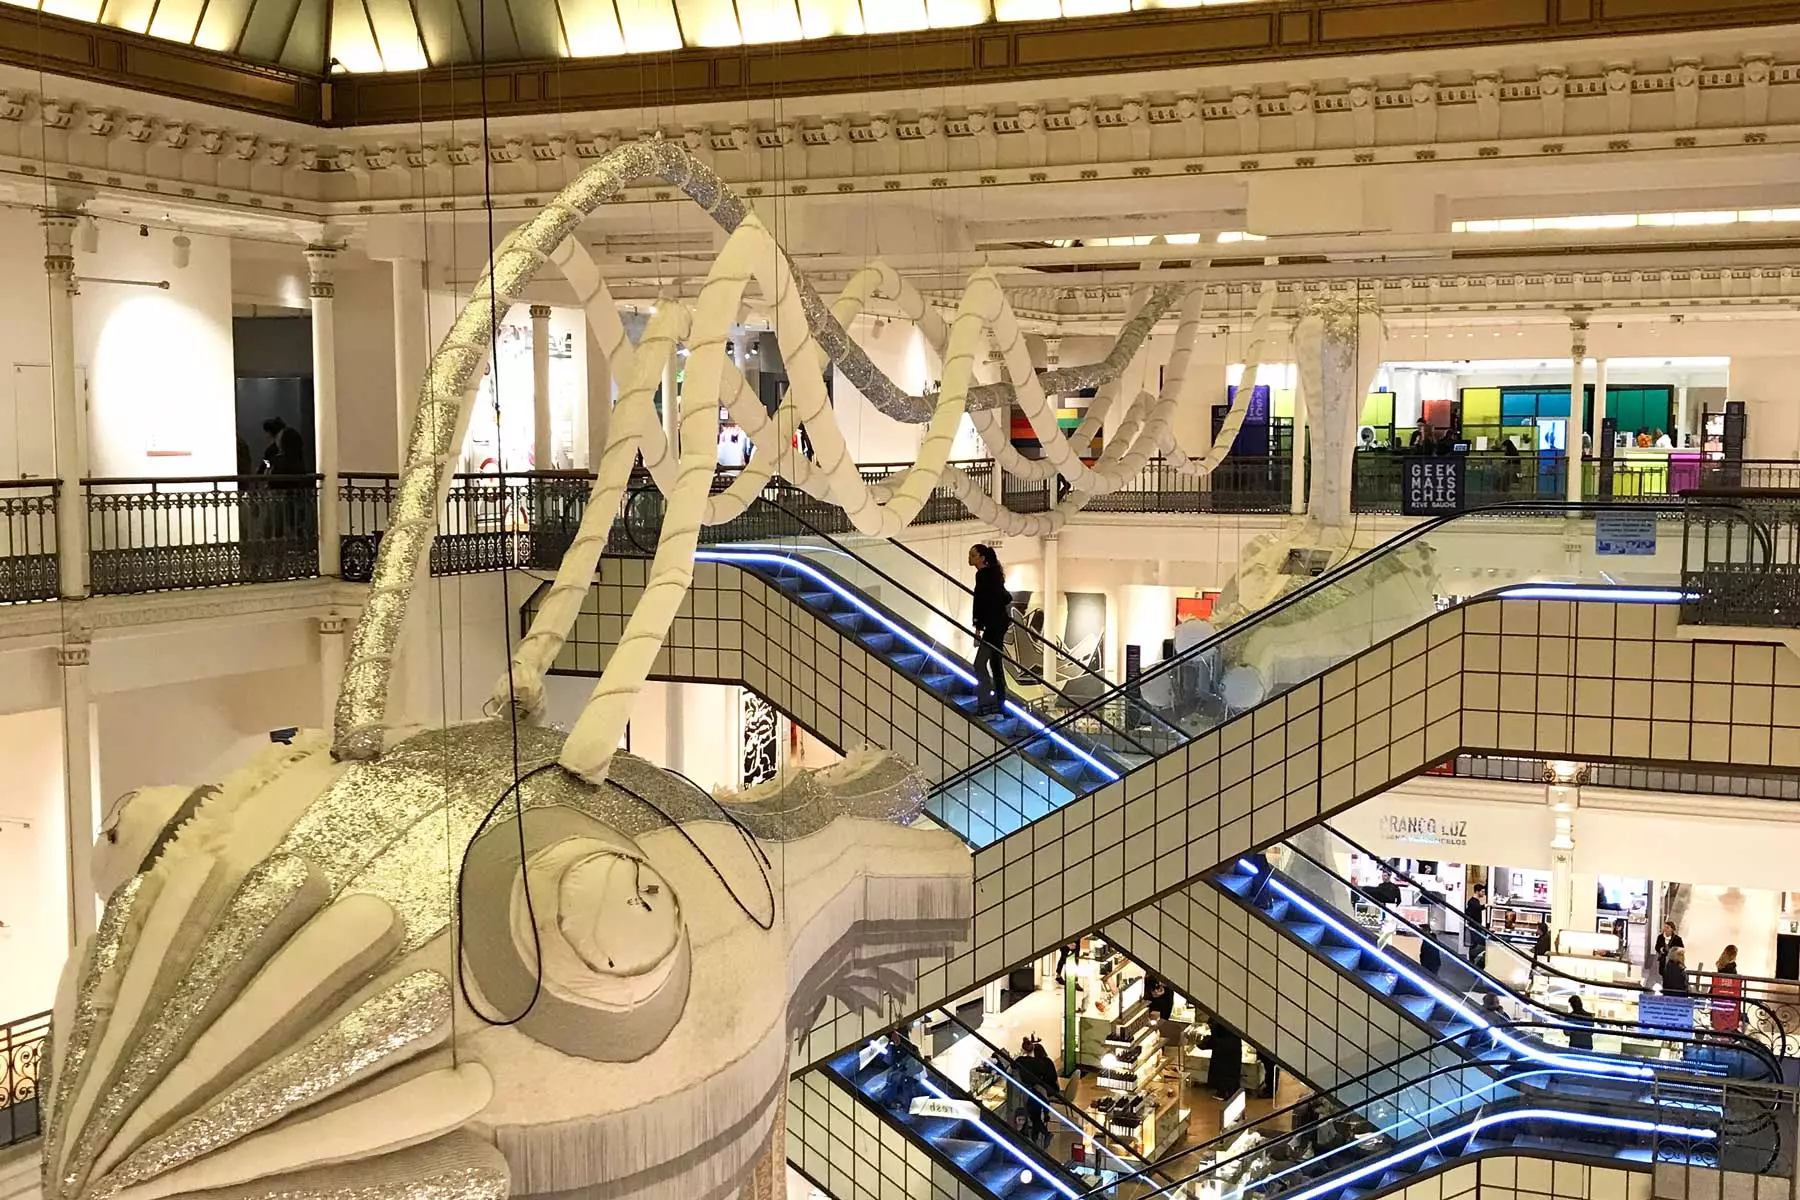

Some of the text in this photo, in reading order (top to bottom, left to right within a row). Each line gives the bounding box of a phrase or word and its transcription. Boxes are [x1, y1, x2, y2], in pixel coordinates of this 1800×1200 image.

[1411, 464, 1457, 477] GEEK
[1411, 477, 1456, 489] MAIS
[1411, 489, 1456, 501] CHIC
[1442, 820, 1467, 837] LUZ
